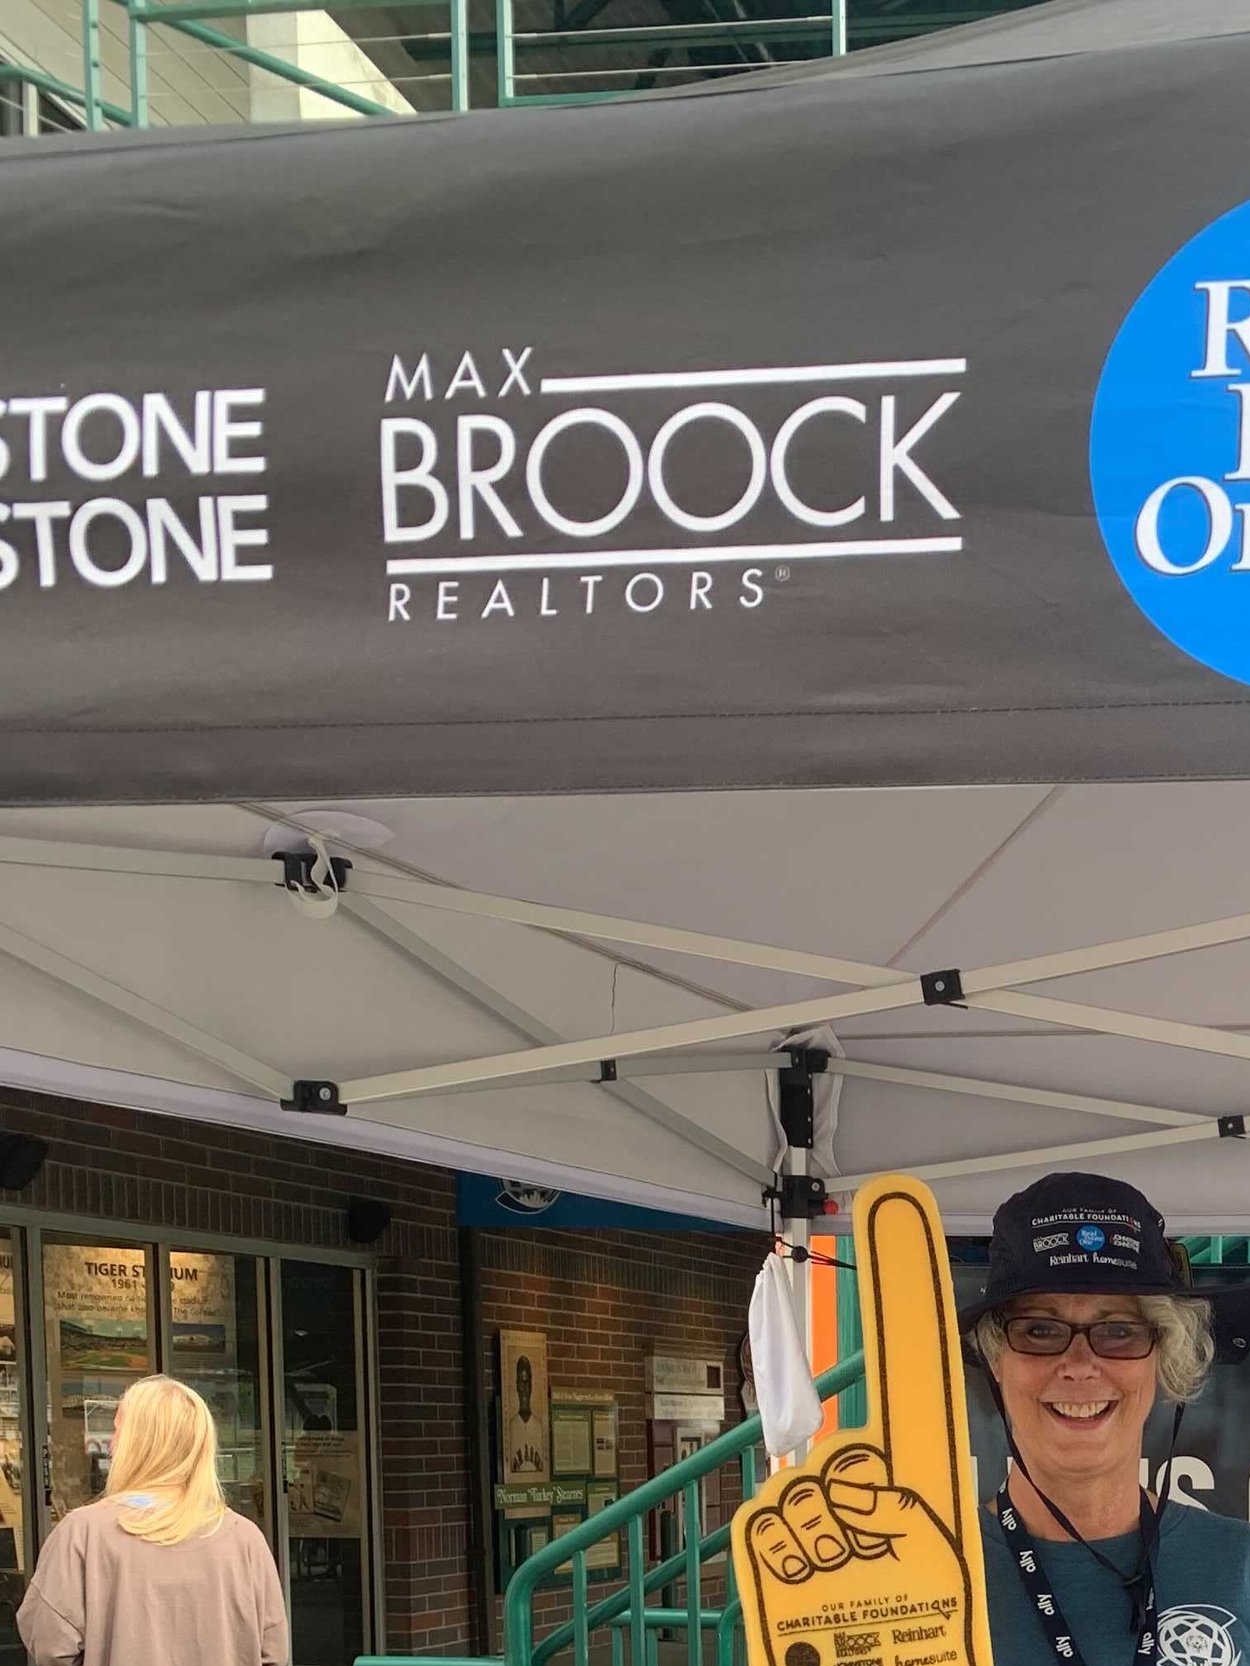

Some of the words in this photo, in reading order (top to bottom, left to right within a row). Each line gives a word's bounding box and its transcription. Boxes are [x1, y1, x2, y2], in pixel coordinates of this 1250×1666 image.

[384, 345, 535, 403] MAX
[380, 391, 962, 543] BROOCK
[1031, 1213, 1085, 1226] CHARITABLE
[84, 1261, 127, 1277] TIGER
[111, 1278, 137, 1289] 1961
[1001, 1507, 1018, 1532] ally
[1019, 1549, 1037, 1574] ally
[776, 1611, 858, 1632] CHARITABLE
[862, 1597, 958, 1621] FOUNDATIONS
[821, 1601, 845, 1613] OUR
[849, 1596, 890, 1609] FAMILY
[895, 1594, 909, 1604] OF
[1037, 1593, 1055, 1616] ally
[892, 1624, 947, 1644] Reinhart
[1137, 1631, 1155, 1656] ally
[1055, 1635, 1074, 1658] ally
